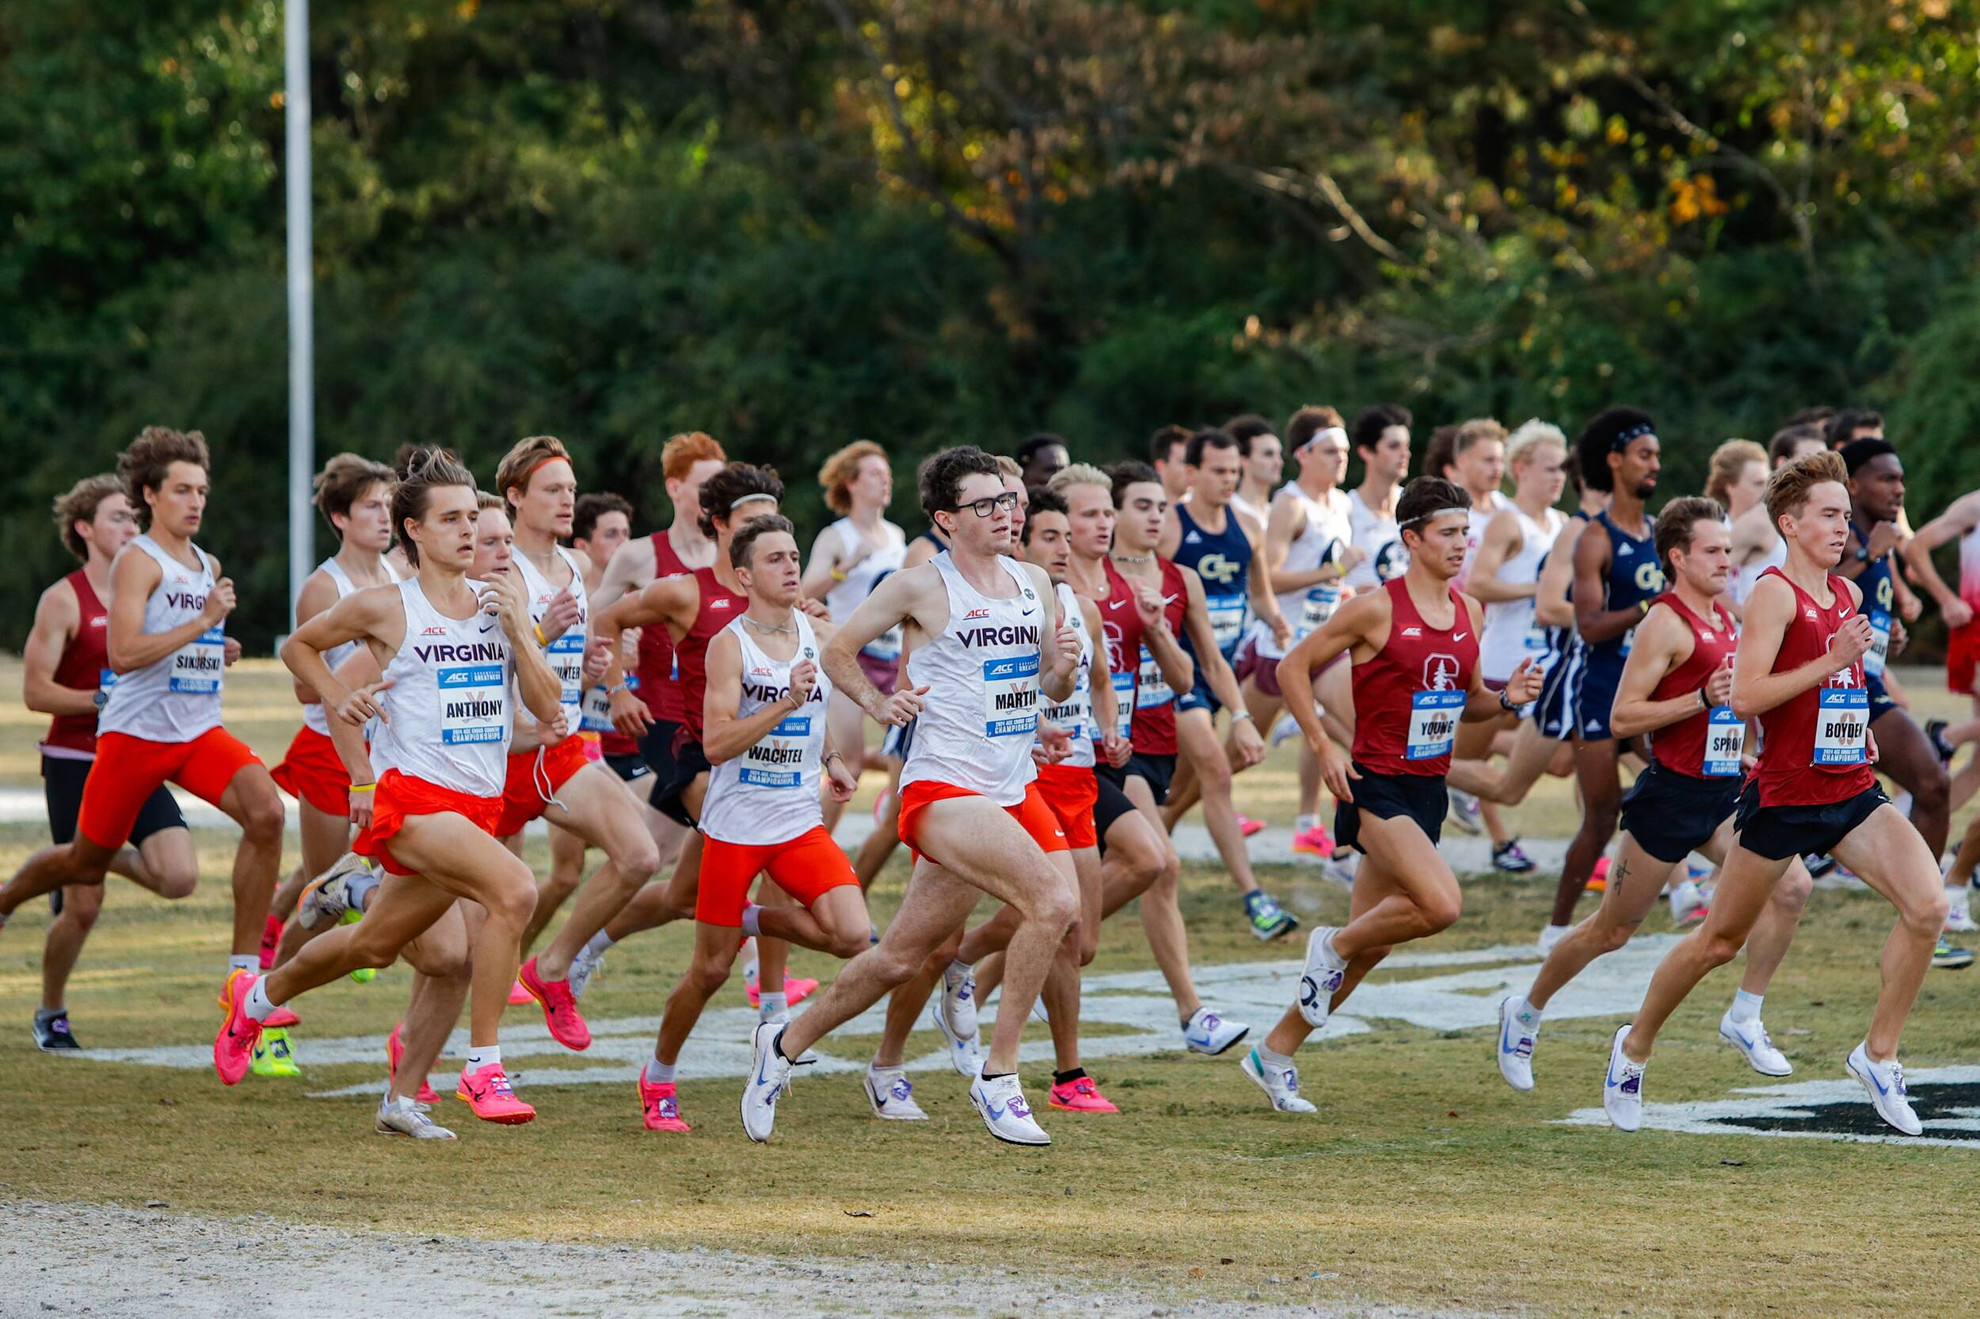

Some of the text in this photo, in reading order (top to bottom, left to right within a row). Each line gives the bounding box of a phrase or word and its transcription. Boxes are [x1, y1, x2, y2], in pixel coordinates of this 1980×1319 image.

[965, 608, 989, 618] ACC
[422, 626, 446, 635] ACC
[955, 625, 1040, 649] VIRGINI
[413, 642, 505, 664] VIRGINIA
[752, 667, 773, 675] ACC
[991, 663, 1014, 674] ACC
[445, 672, 469, 683] ACC
[995, 689, 1037, 711] MARTIN
[1825, 693, 1847, 704] ACC
[446, 699, 503, 719] ANTHONY
[1041, 703, 1081, 721] UNTAIN
[1421, 720, 1454, 736] YOUNG
[1825, 723, 1864, 738] BOYDEN
[748, 745, 803, 764] WACHTEL
